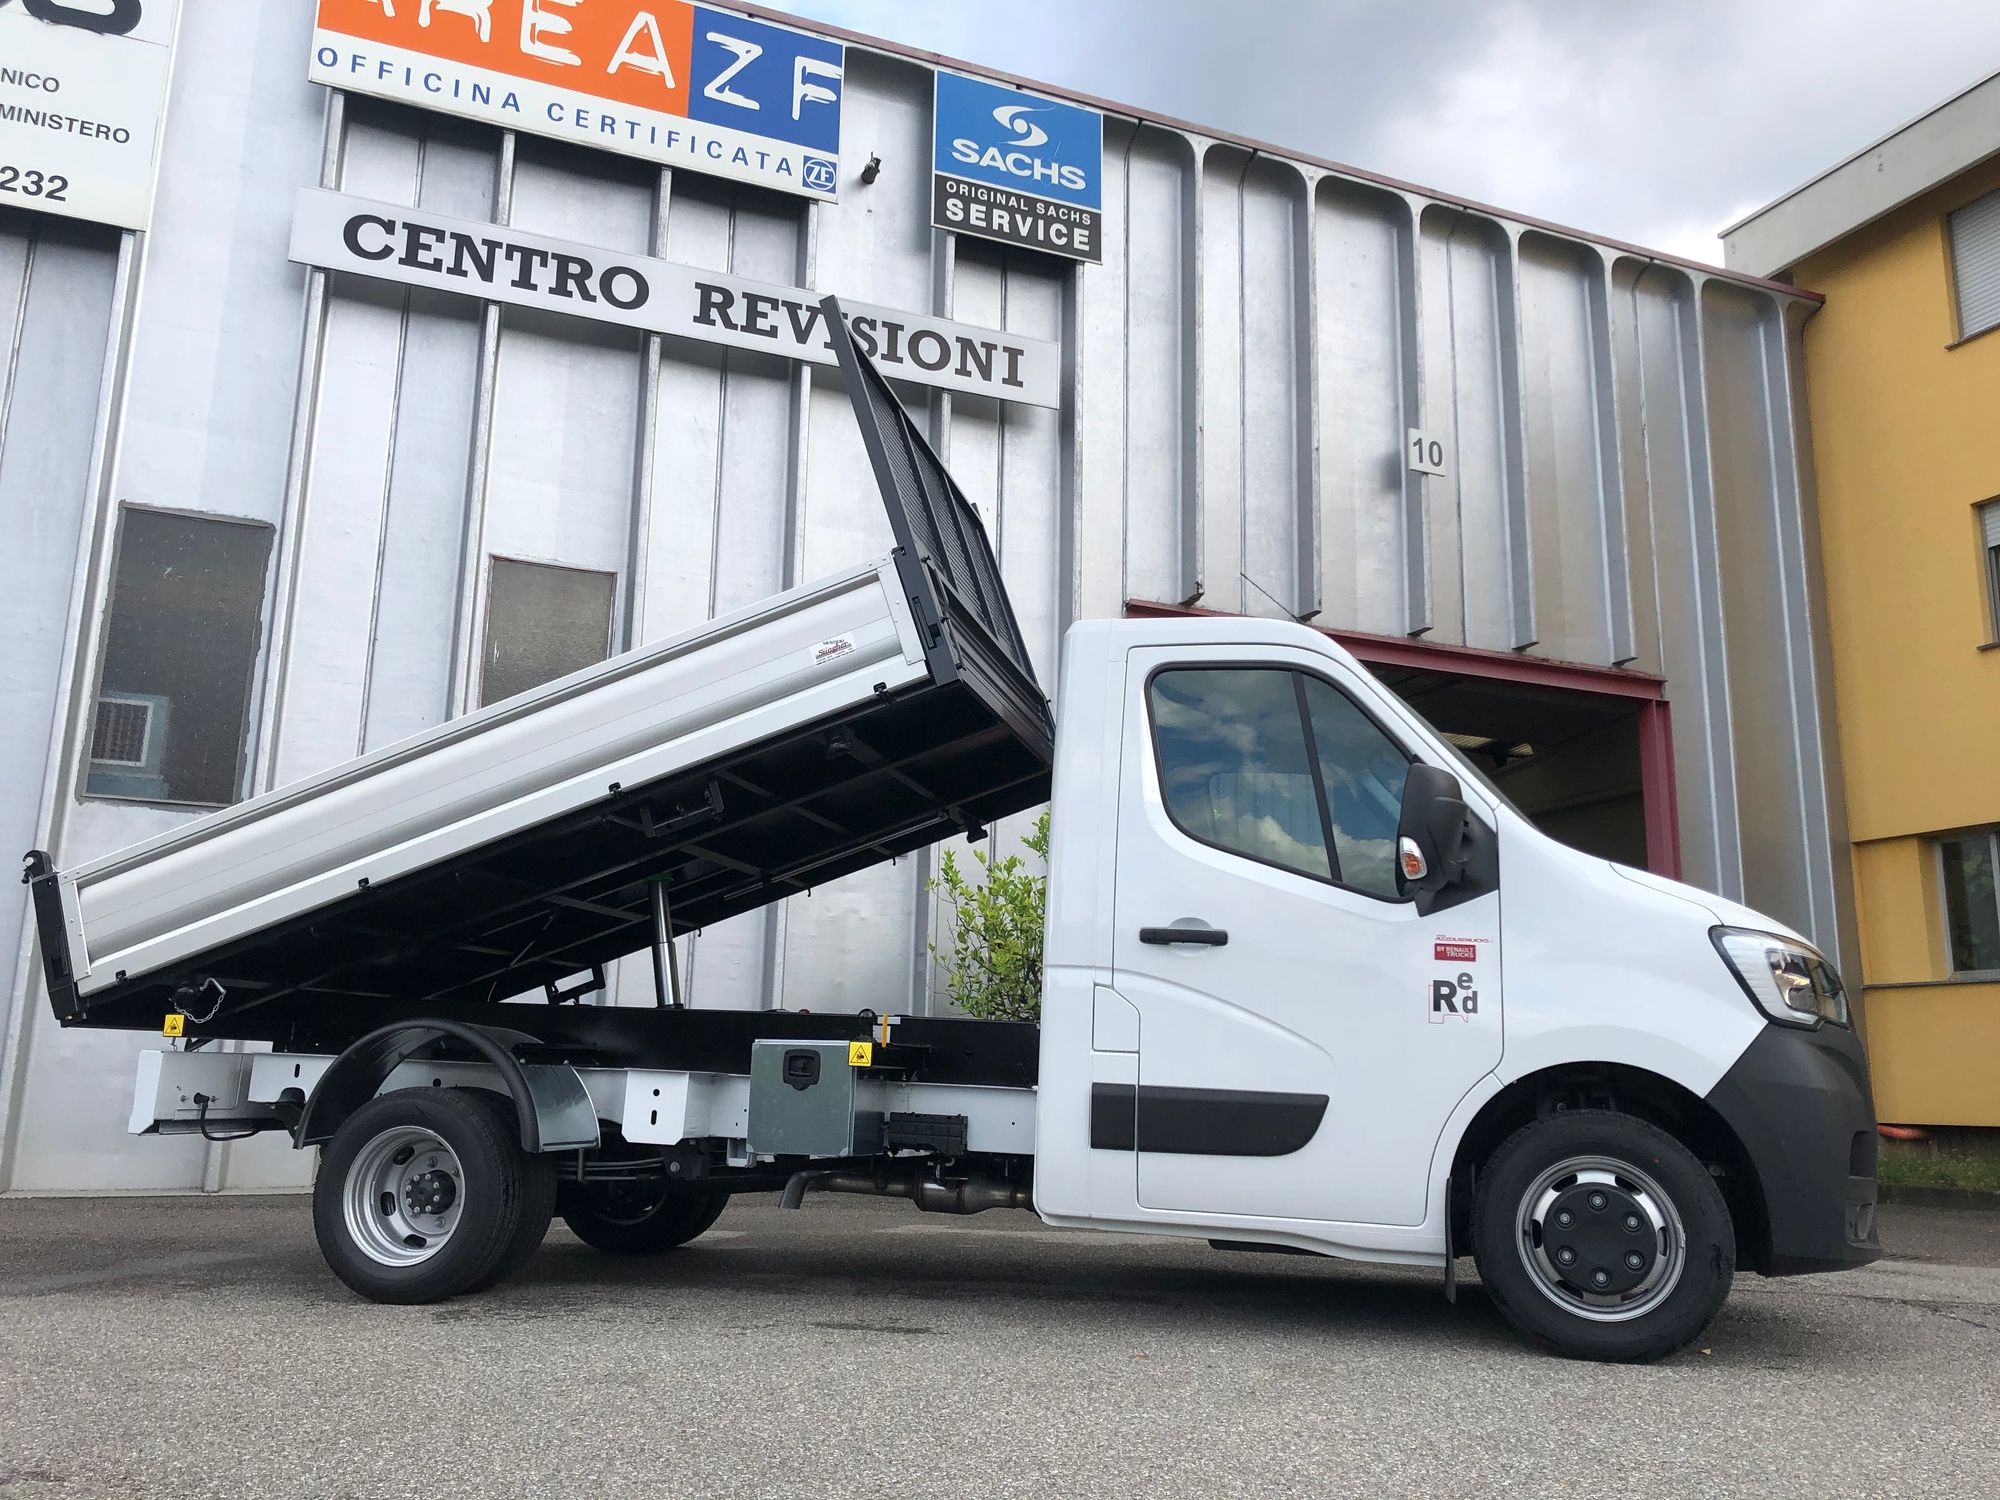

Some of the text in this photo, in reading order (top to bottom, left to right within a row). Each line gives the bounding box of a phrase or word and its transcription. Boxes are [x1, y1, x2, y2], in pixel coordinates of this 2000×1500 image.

[0, 67, 60, 93] NICO
[371, 0, 841, 121] REA ZF
[0, 103, 130, 144] MINISTERO
[317, 47, 793, 177] OFFICINA CERTIFICATA
[0, 165, 69, 202] 232
[807, 162, 834, 187] ZF
[951, 138, 1087, 190] SACHS
[945, 180, 1091, 225] ORIGINAL SACHS
[945, 198, 1090, 252] SERVICE
[342, 213, 650, 311] CENTRO
[1412, 437, 1443, 468] 10
